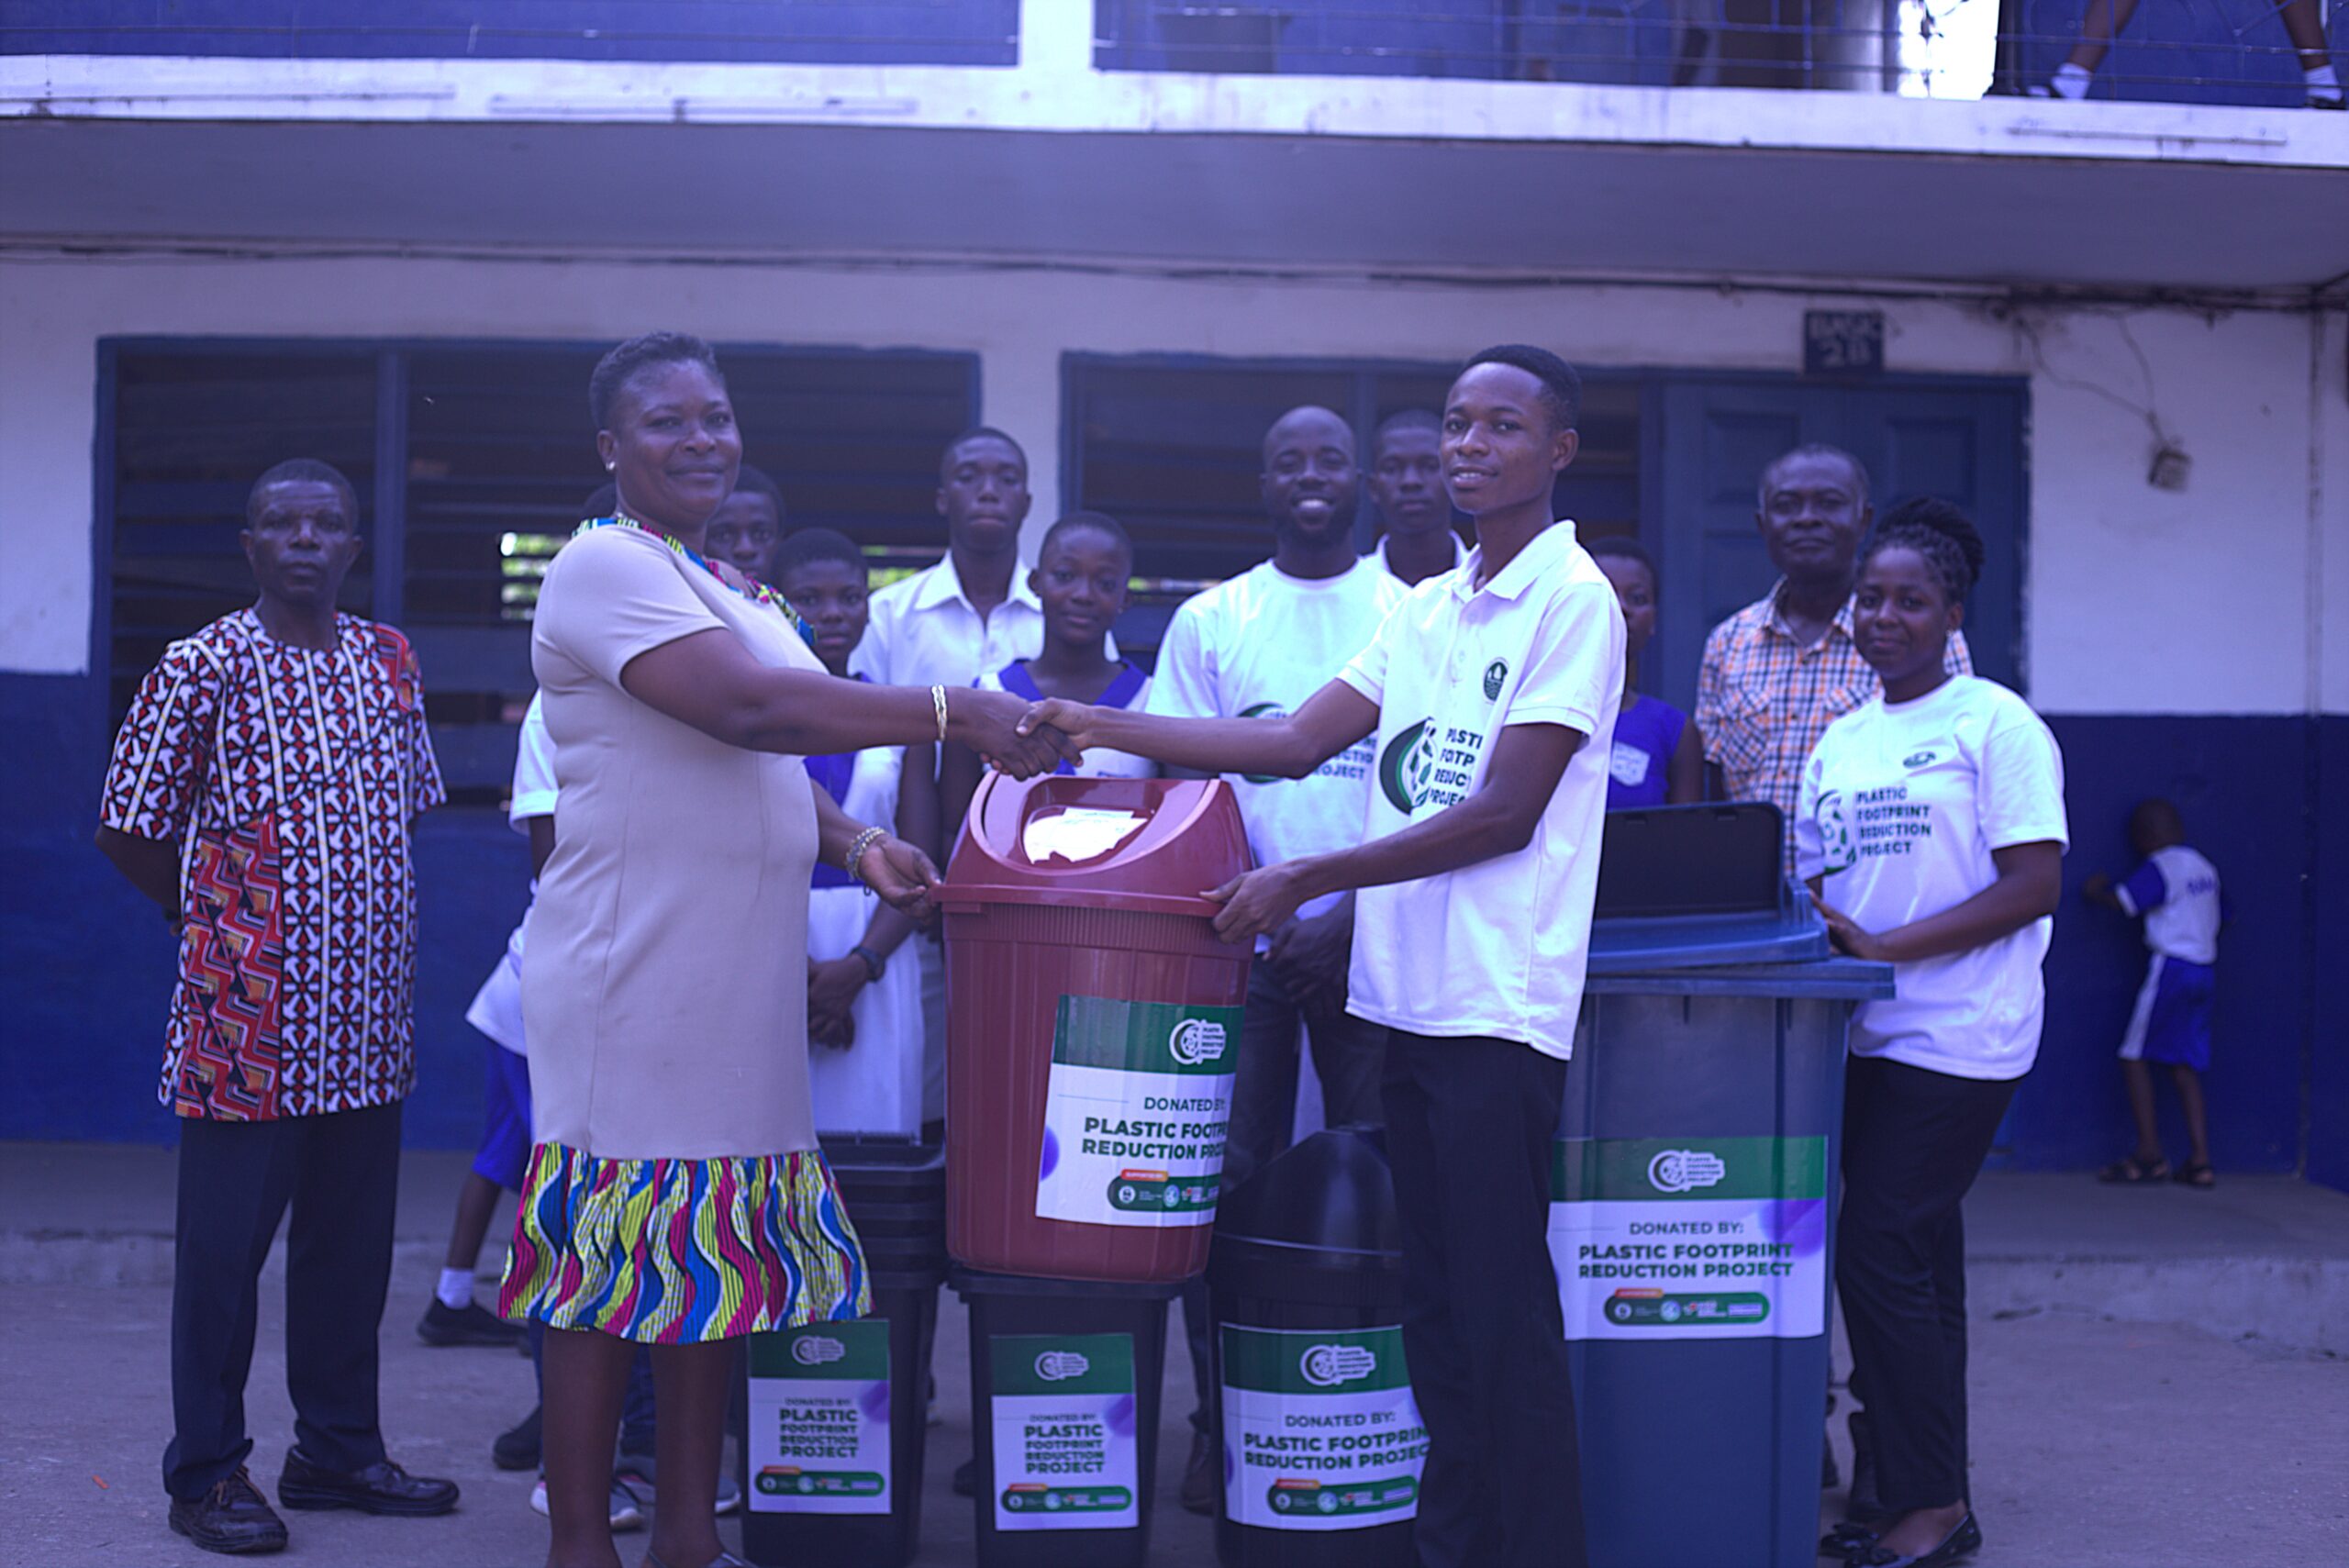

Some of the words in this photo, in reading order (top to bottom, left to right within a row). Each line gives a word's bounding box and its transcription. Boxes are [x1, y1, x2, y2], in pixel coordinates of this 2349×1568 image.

[1857, 805, 1930, 821] FOOTPRINT
[1860, 823, 1931, 839] REDUCTION
[1144, 1097, 1212, 1111] DONATED
[1085, 1117, 1175, 1139] PLASTIC
[1082, 1139, 1197, 1160] REDUCTION
[1630, 1222, 1711, 1235] DONATED
[1719, 1221, 1744, 1234] BY:
[1579, 1244, 1666, 1260] PLASTIC
[1674, 1243, 1794, 1259] FOOTPRINT
[1579, 1263, 1697, 1278] REDUCTION
[1704, 1262, 1794, 1277] PROJECT
[785, 1397, 834, 1407] DONATED
[780, 1408, 858, 1422] PLASTIC
[1030, 1414, 1078, 1422] DONATED
[1286, 1412, 1366, 1428] DONATED
[1372, 1410, 1396, 1424] BY:
[780, 1424, 857, 1433] FOOTPRINT
[1025, 1424, 1103, 1439] PLASTIC
[780, 1435, 858, 1445] REDUCTION
[1026, 1440, 1103, 1450] FOOTPRINT
[1244, 1432, 1322, 1451] PLASTIC
[780, 1446, 858, 1458] PROJECT
[1026, 1451, 1104, 1461] REDUCTION
[1026, 1462, 1105, 1473] PROJECT
[1244, 1451, 1353, 1470] REDUCTION
